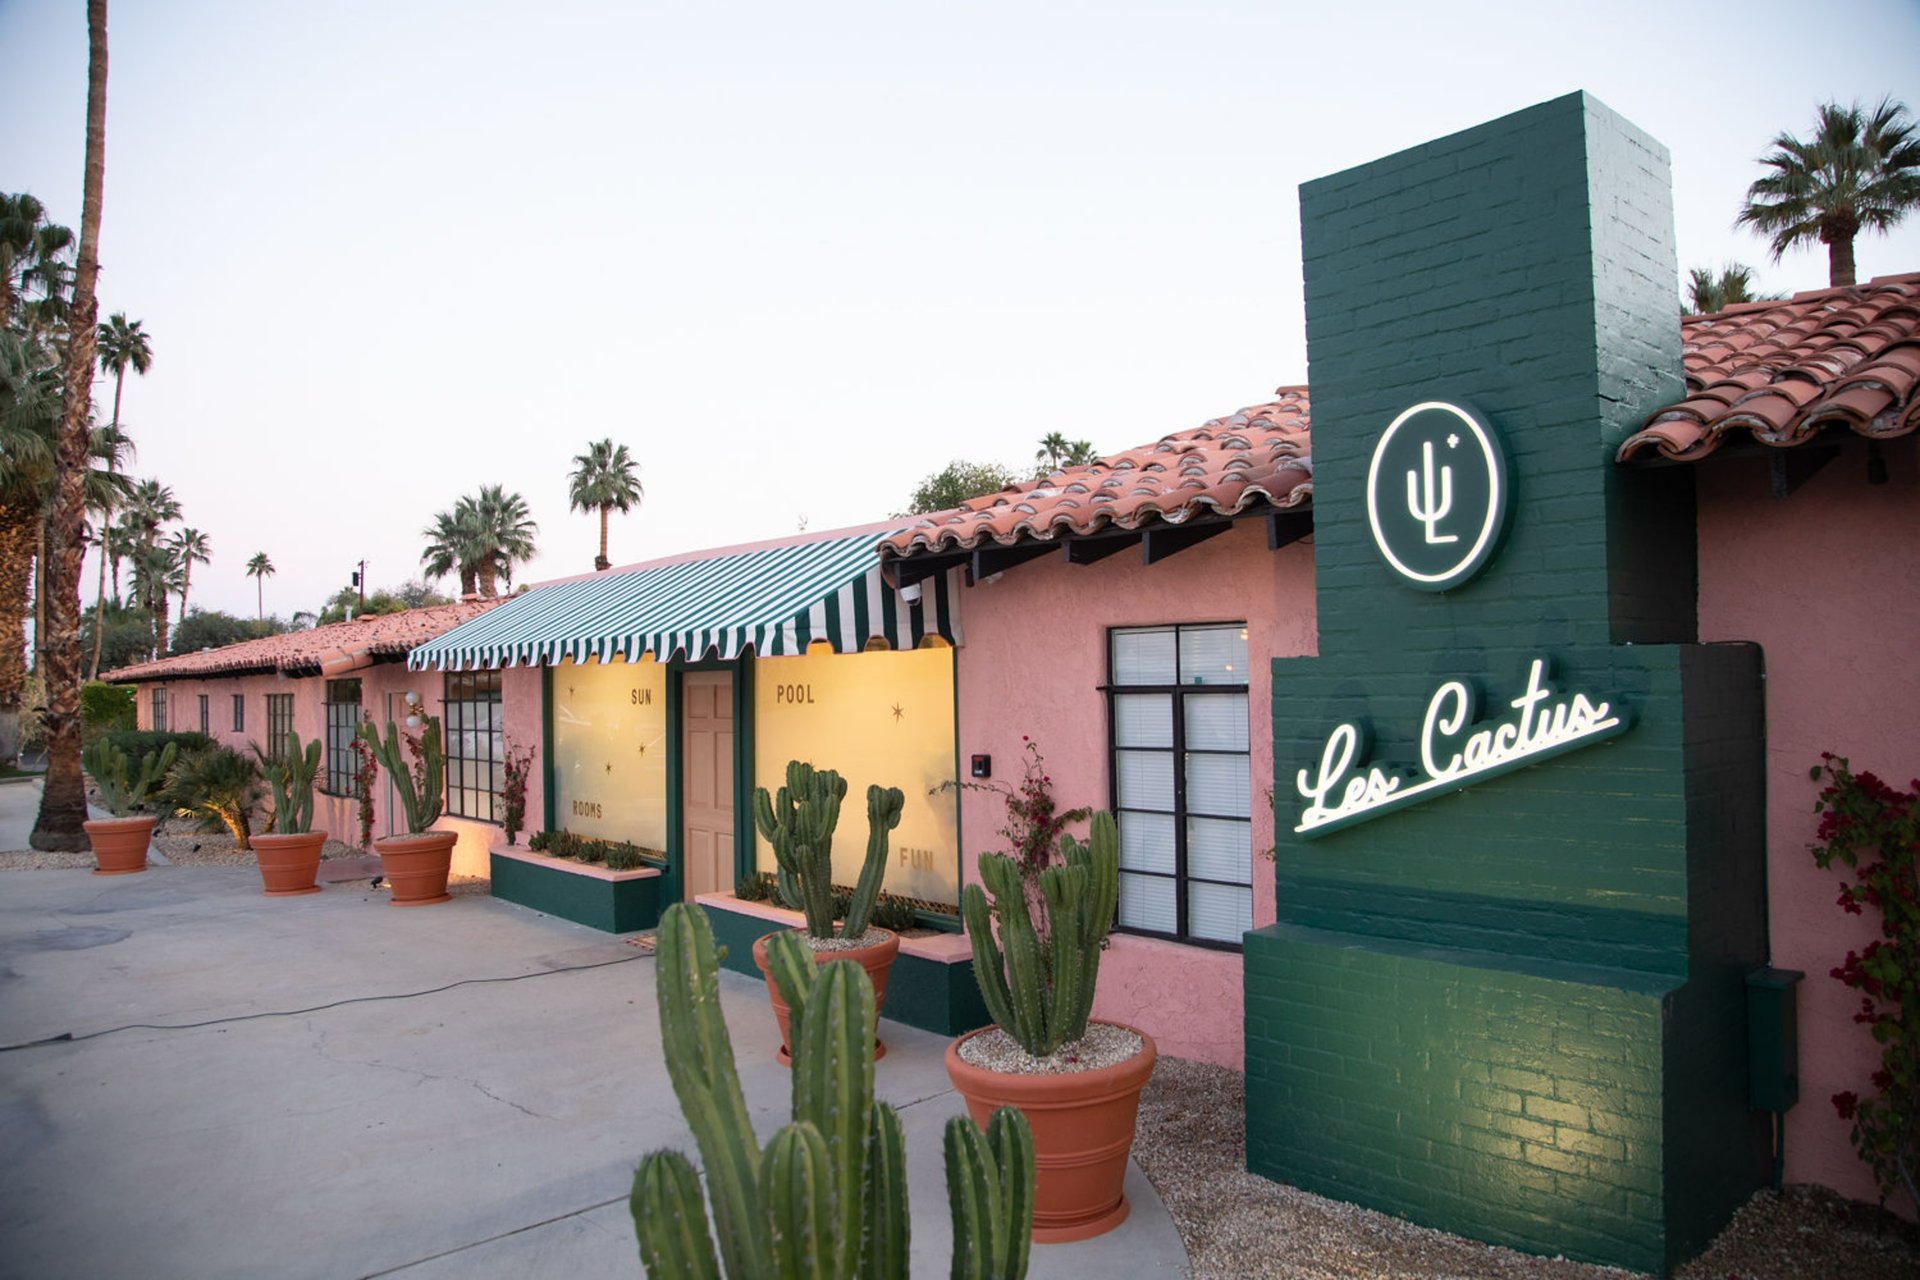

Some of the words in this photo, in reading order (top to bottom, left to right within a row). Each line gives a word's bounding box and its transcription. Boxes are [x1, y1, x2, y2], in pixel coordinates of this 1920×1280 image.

[631, 689, 651, 705] SUN
[777, 684, 815, 704] POOL
[1296, 724, 1399, 828] Les
[1421, 659, 1610, 780] Cactus
[573, 800, 602, 819] ROOMS
[900, 847, 933, 871] FUN
